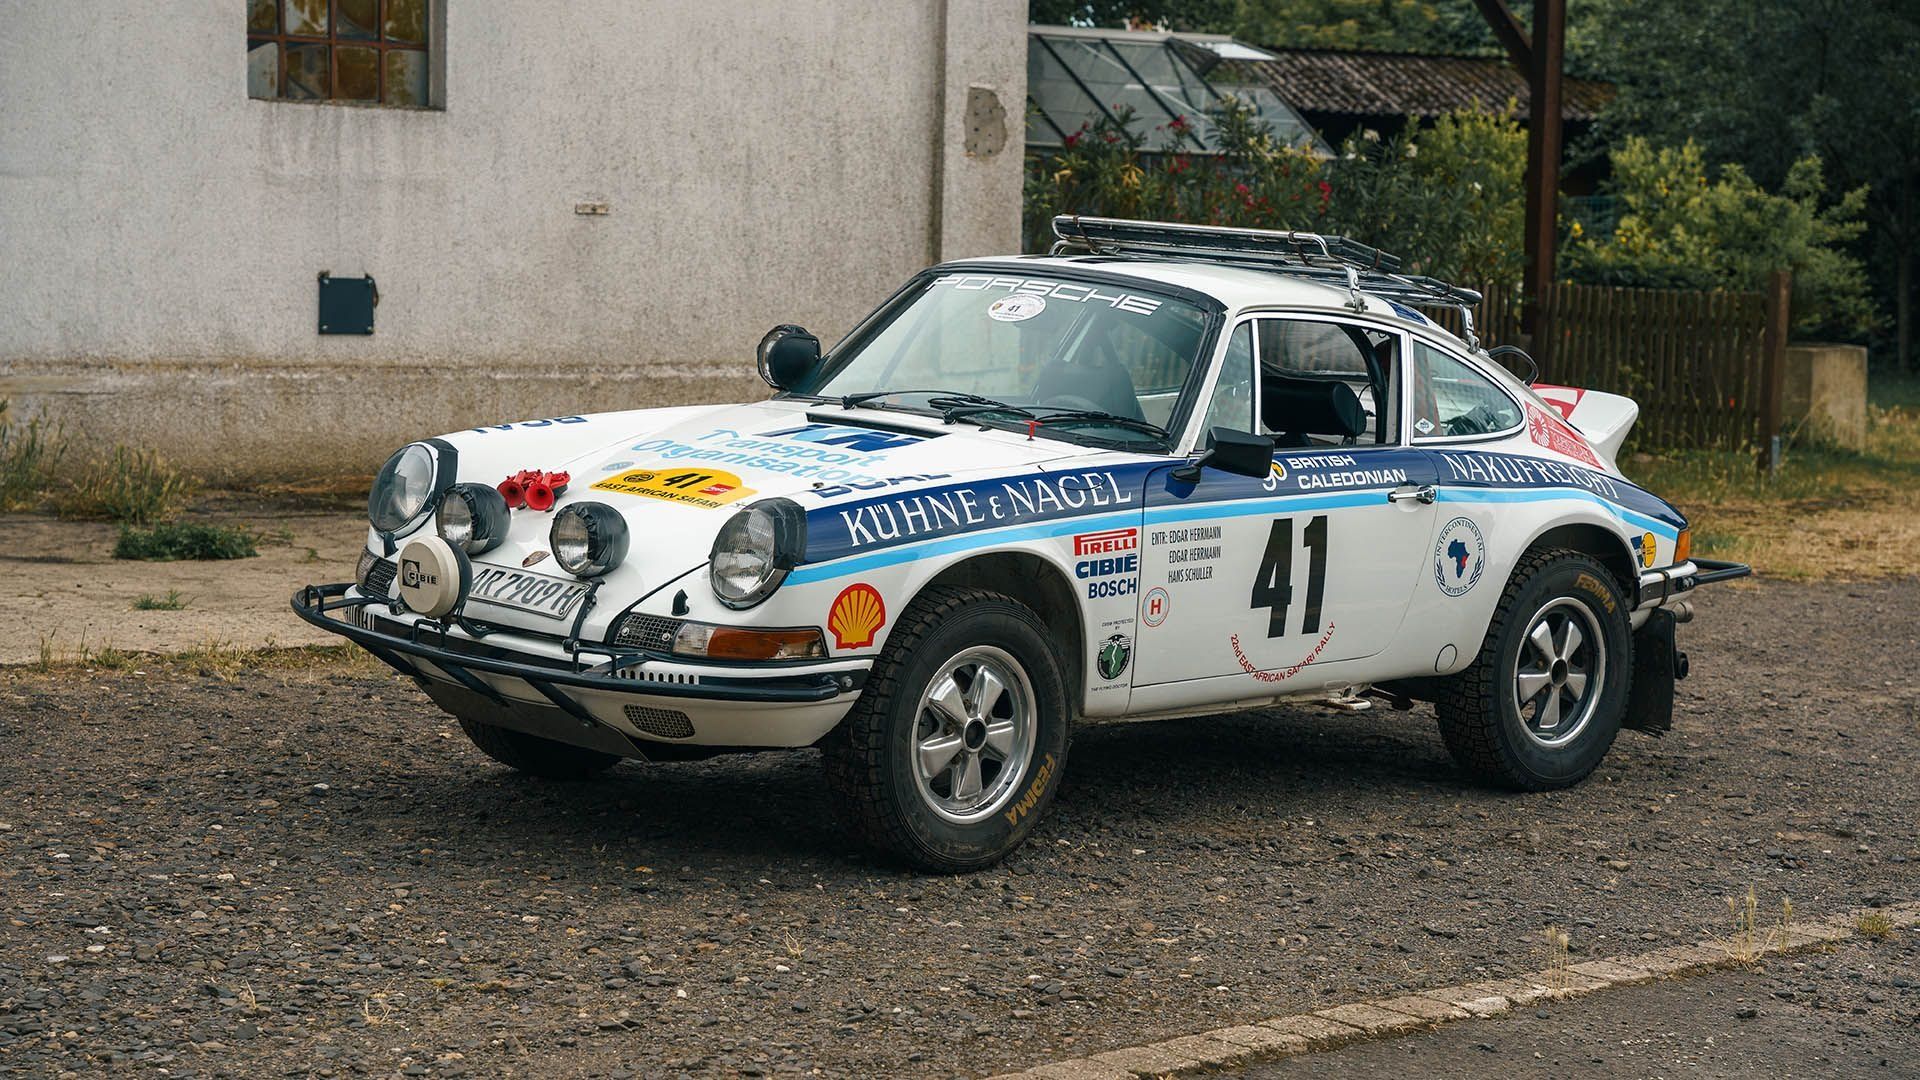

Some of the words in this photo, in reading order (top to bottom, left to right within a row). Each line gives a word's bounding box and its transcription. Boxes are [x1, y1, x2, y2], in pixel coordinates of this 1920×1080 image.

[926, 276, 1163, 316] PORSCHE
[631, 439, 877, 485] Organisation
[698, 429, 888, 468] Transport
[1286, 454, 1357, 470] BRITISH
[662, 472, 714, 489] 41
[1297, 468, 1407, 490] CALEDONIAN
[1444, 453, 1620, 499] NAKUFREIGHT
[595, 482, 625, 491] EAST
[627, 485, 679, 499] AFRICAN
[676, 494, 722, 508] SAFARI
[840, 489, 985, 547] KÜHNE
[1001, 471, 1132, 518] NAGEL
[1074, 528, 1137, 556] PIRELLI
[1151, 531, 1168, 545] ENTR:
[1169, 528, 1188, 544] EDGAR
[1189, 526, 1222, 541] HERRMANN
[1436, 520, 1483, 556] INTERCONTINENTAL
[1169, 549, 1188, 564] EDGAR
[1189, 546, 1221, 562] HERRMANN
[1088, 577, 1137, 599] BOSCH
[1168, 569, 1184, 584] HANS
[1185, 566, 1213, 582] SCHULLER
[1250, 515, 1328, 638] 41
[1446, 584, 1468, 594] HOTELS
[1150, 598, 1162, 615] H
[1573, 573, 1616, 614] FEDIMA
[1230, 634, 1243, 658] 22nd
[1239, 655, 1256, 673] EAST
[1253, 671, 1286, 683] AFRICAN
[1287, 653, 1315, 678] SAFARI
[1315, 621, 1335, 655] RALLY
[1004, 752, 1056, 826] FEDIMA
